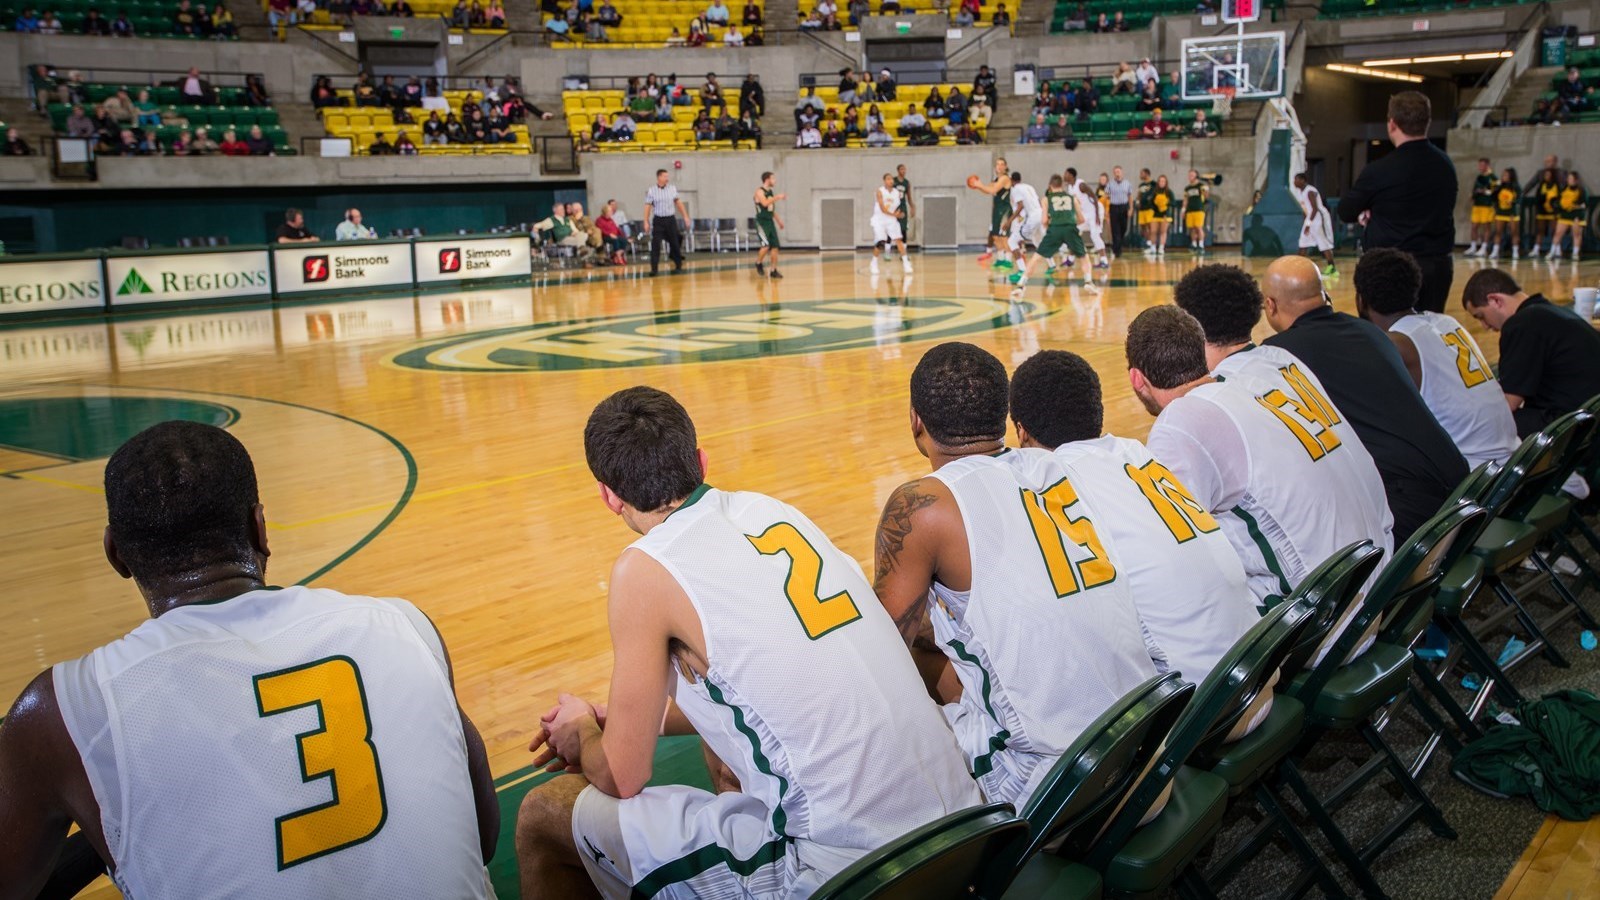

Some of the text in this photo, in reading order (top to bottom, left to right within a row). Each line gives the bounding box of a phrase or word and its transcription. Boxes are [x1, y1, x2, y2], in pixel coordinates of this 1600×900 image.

[335, 256, 389, 267] Simmons
[465, 248, 511, 259] Simmons
[466, 259, 490, 270] Bank
[161, 270, 267, 293] REGIONS
[336, 268, 365, 279] Bank
[0, 280, 99, 304] EGIONS
[1018, 476, 1117, 599] 15
[742, 521, 863, 641] 2
[252, 654, 389, 873] 3
